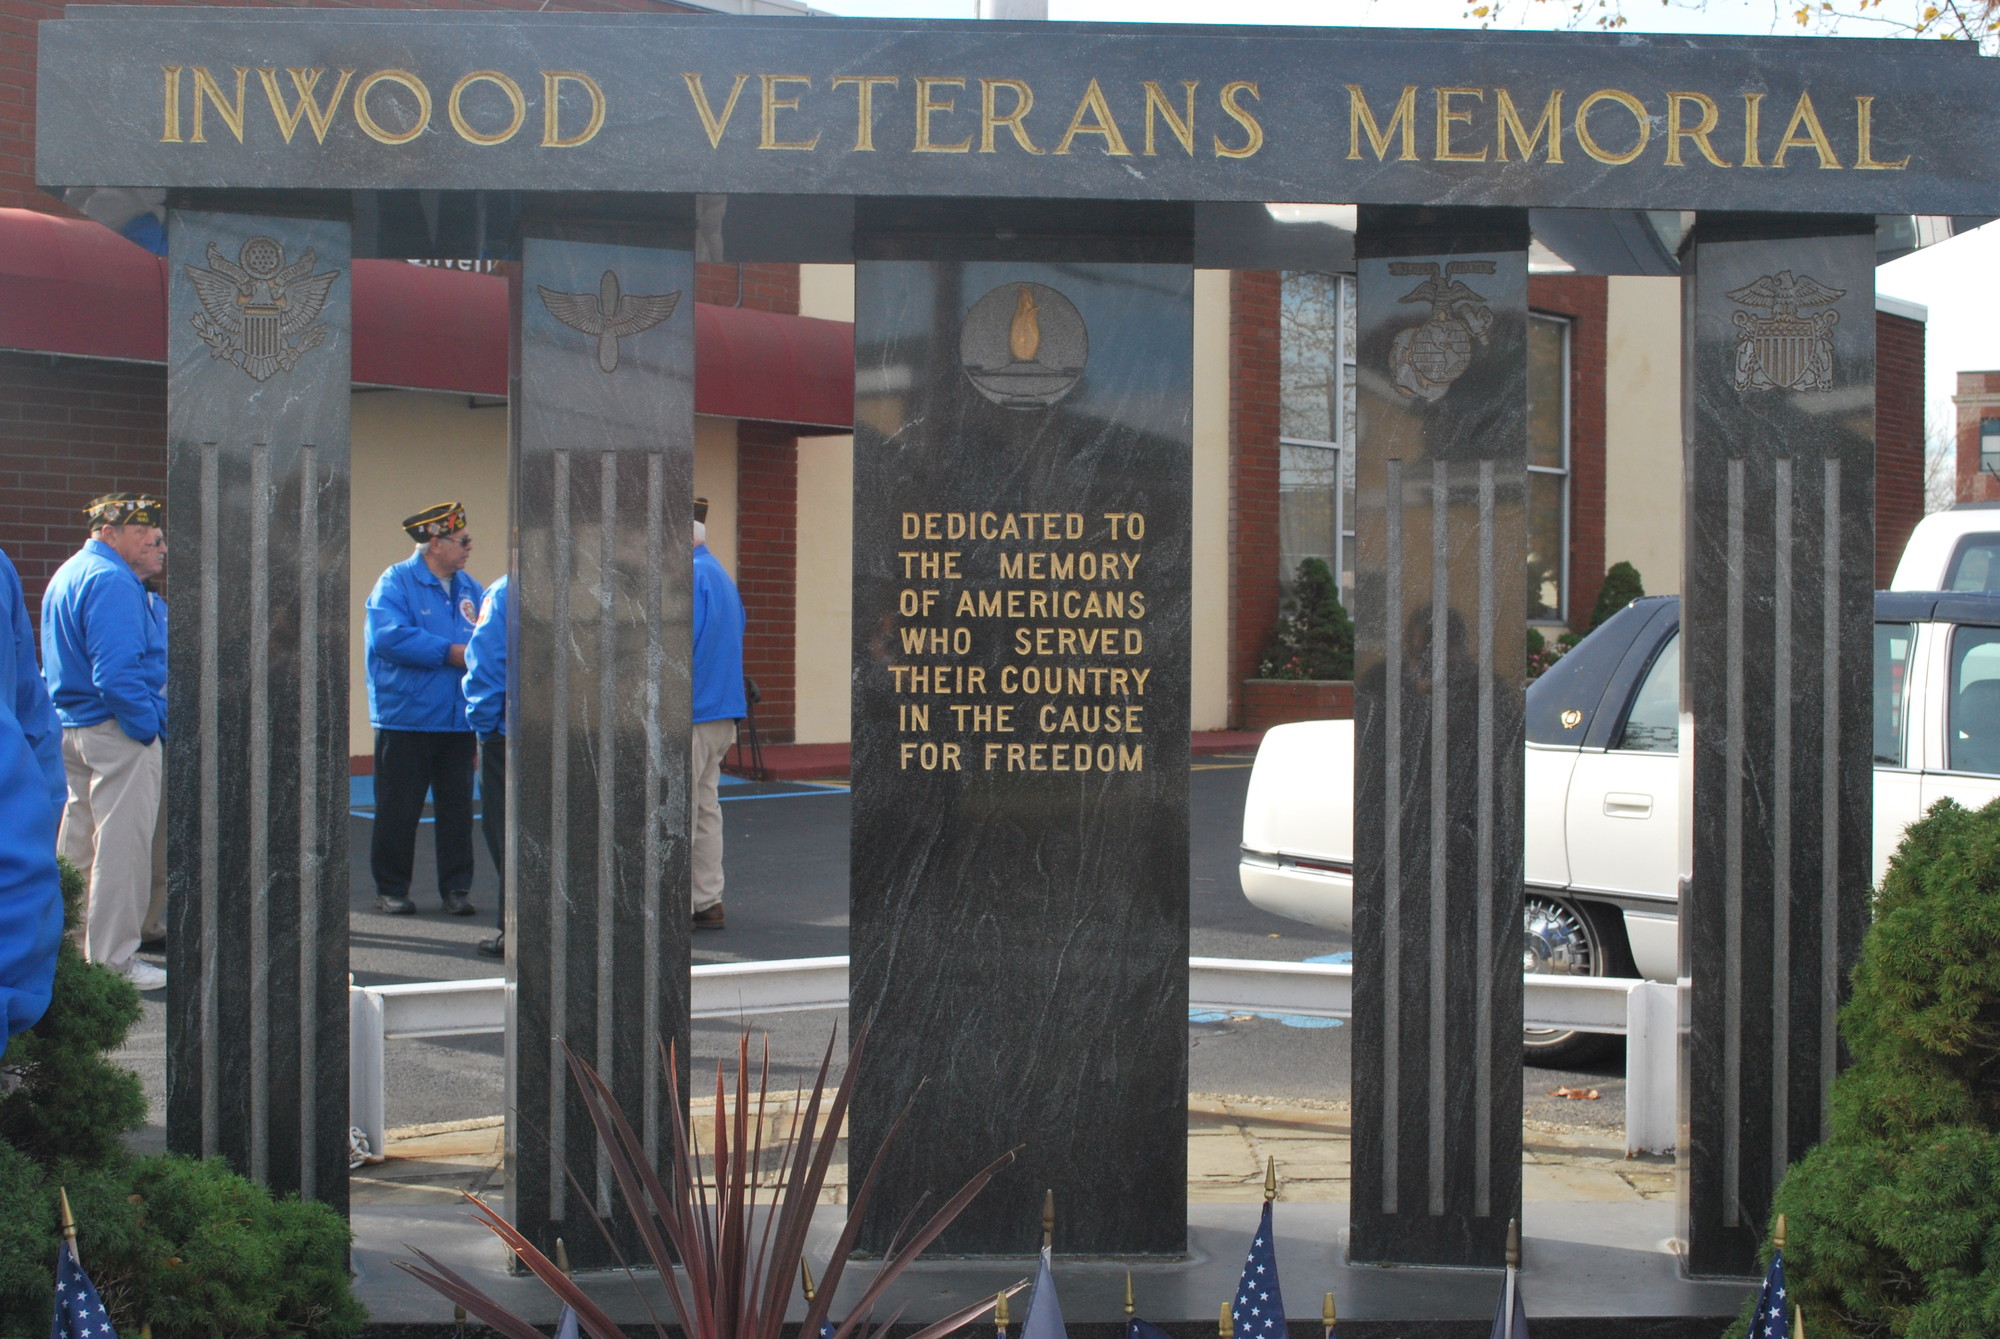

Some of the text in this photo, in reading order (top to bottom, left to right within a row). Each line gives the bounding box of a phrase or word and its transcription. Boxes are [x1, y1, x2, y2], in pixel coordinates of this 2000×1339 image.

[159, 65, 1911, 170] INWOOD VETERANS MEMORIAL
[902, 512, 1145, 540] DEDICATED TO
[898, 552, 1140, 580] THE MEMORY
[900, 589, 1145, 619] OF AMERICANS
[900, 627, 1143, 655] WHO SERVED
[887, 665, 1151, 695] THEIR COUNTRY
[900, 704, 1143, 732] IN THE CAUSE
[901, 742, 1142, 771] FOR FREEDOM
